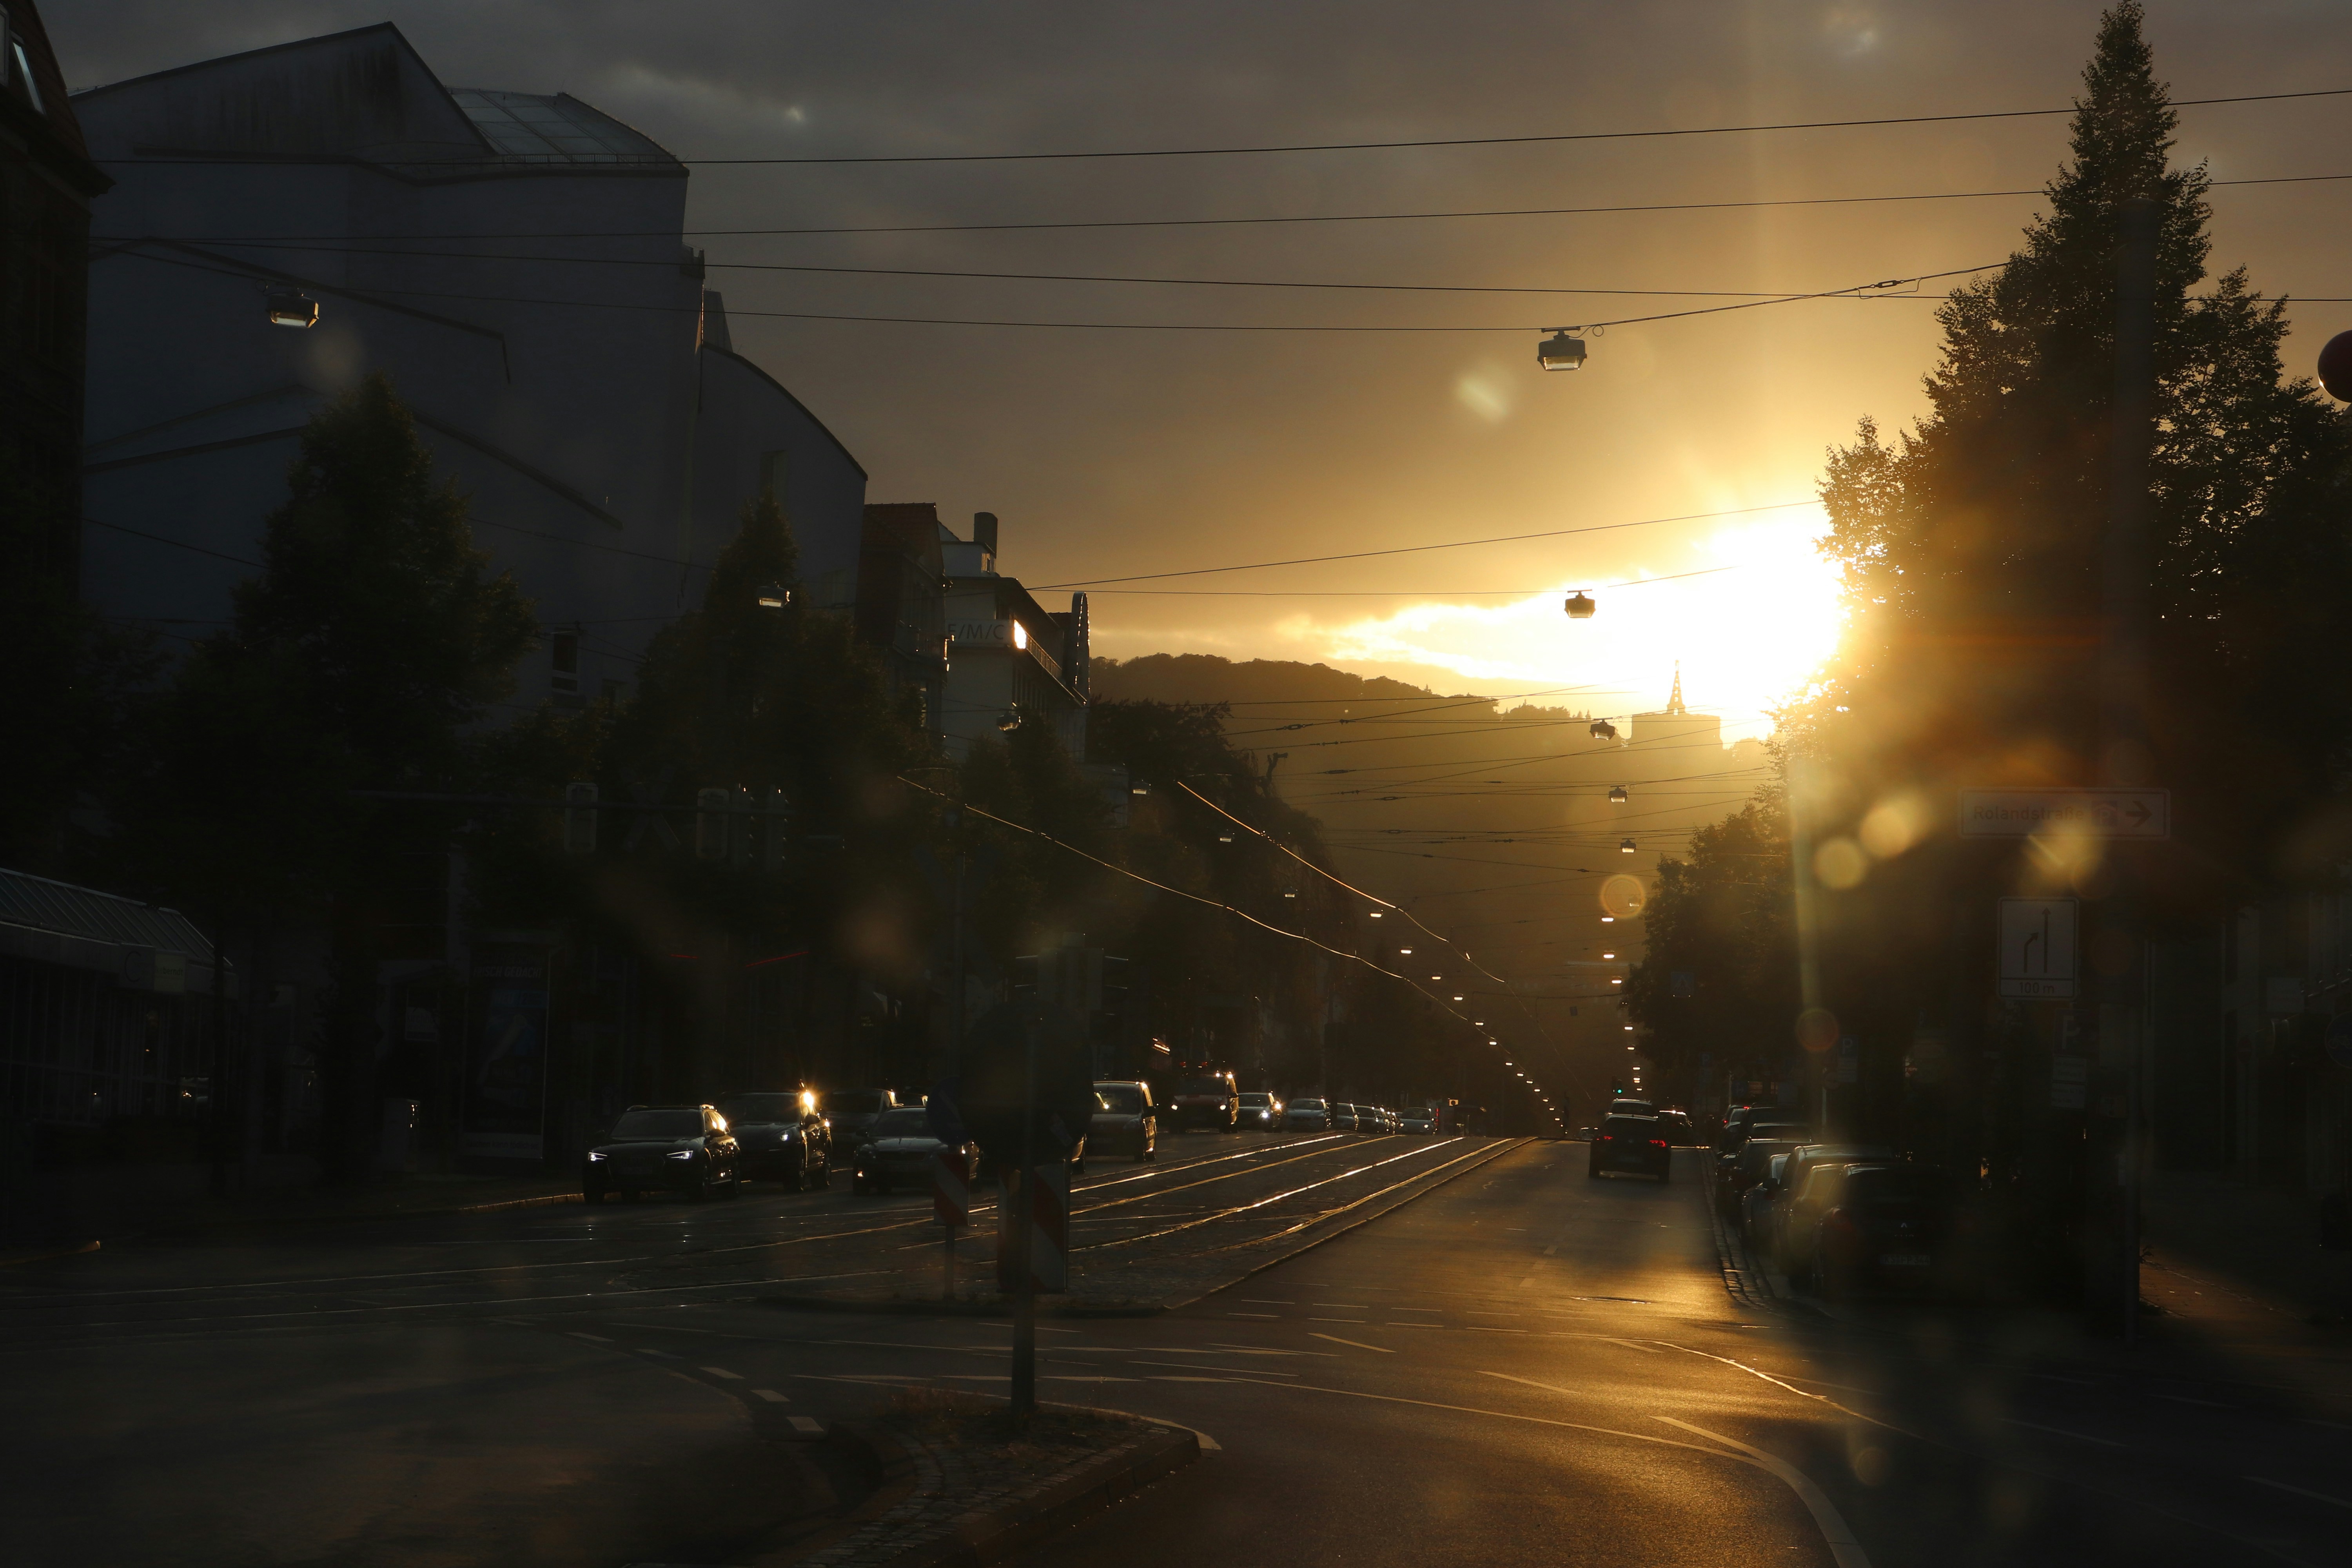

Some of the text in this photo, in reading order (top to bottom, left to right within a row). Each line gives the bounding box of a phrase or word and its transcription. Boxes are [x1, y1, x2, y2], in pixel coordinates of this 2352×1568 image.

[1973, 806, 2084, 820] Rolandstraße
[473, 966, 543, 978] FRISCH GEDACHT
[2019, 982, 2054, 993] 100 m
[510, 1141, 529, 1149] tödlich
